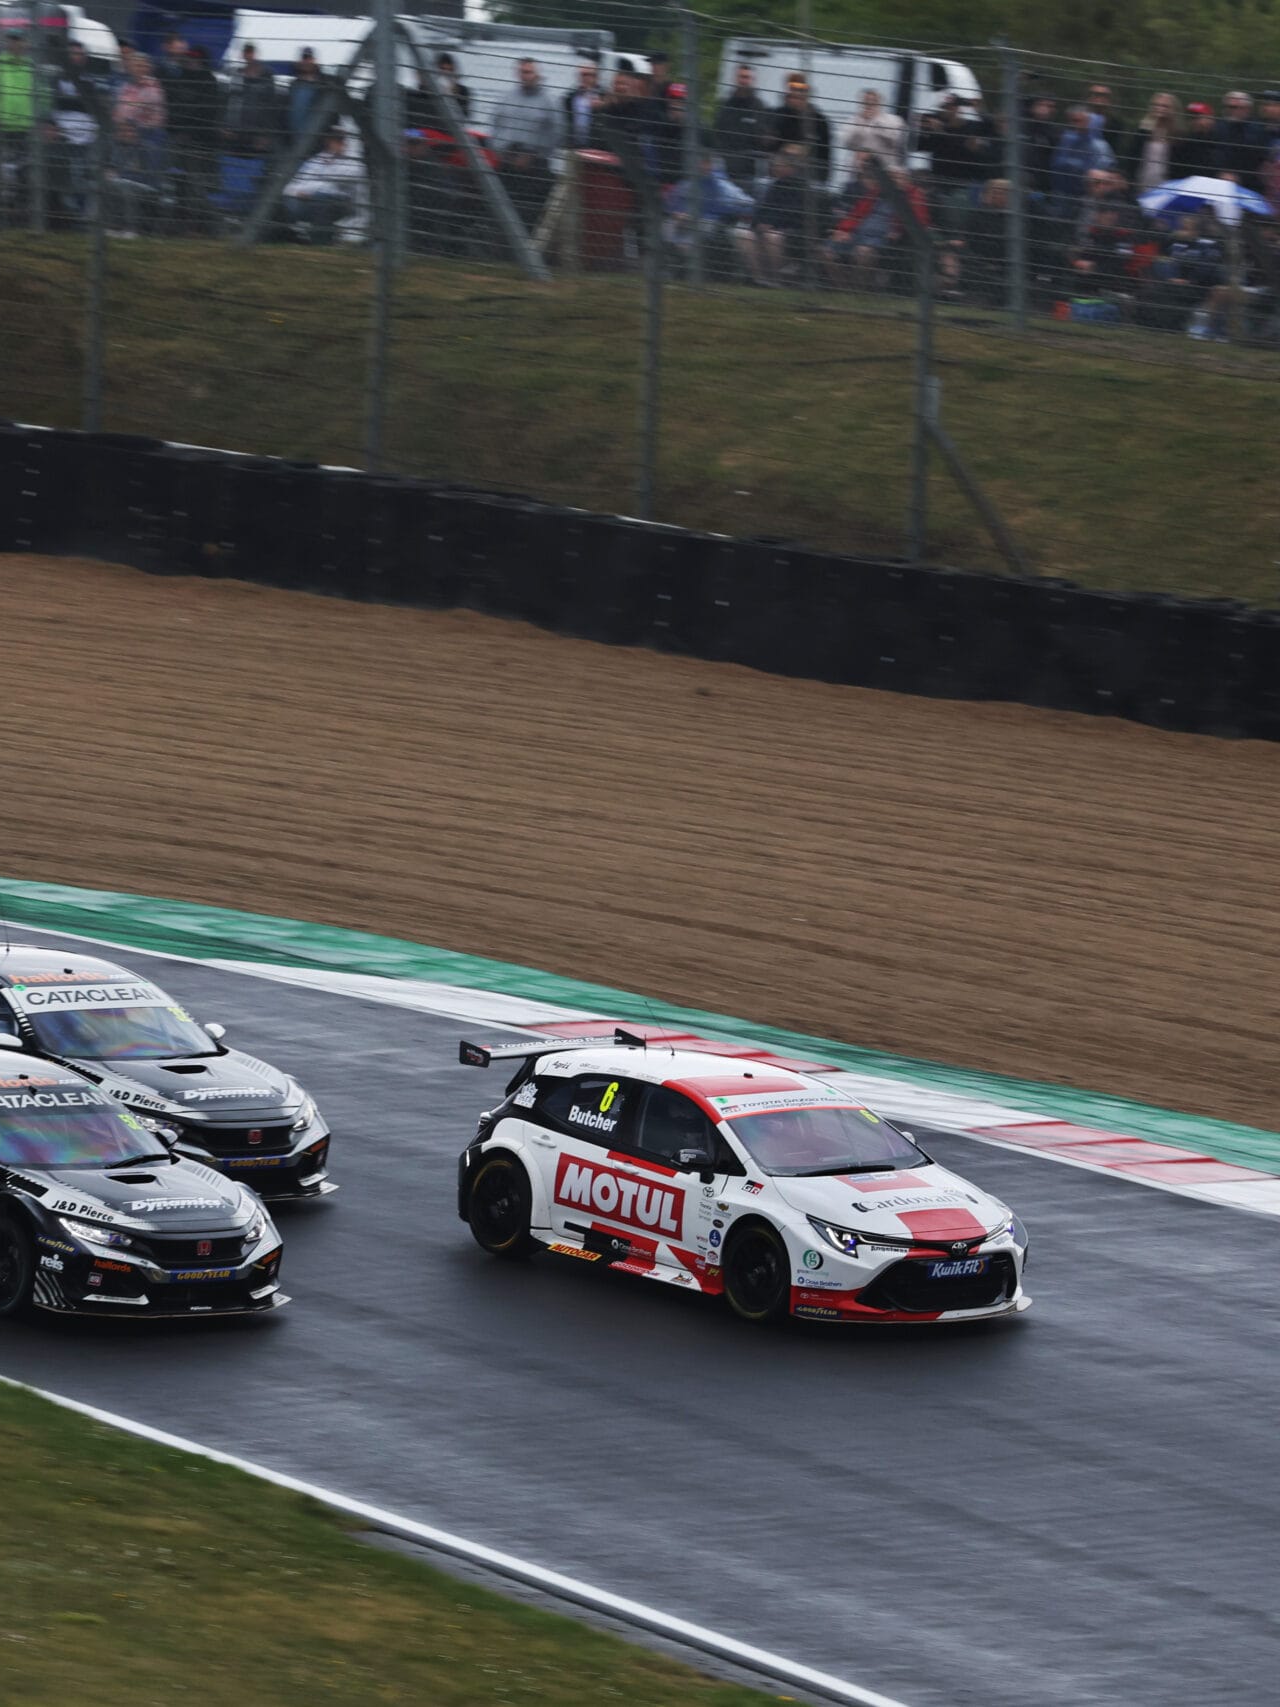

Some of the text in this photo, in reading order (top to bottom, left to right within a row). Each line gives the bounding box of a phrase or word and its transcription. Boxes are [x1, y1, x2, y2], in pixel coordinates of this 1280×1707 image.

[8, 971, 110, 985] halfords
[26, 987, 161, 1006] CATACLEAN
[131, 1094, 167, 1111] Pierce
[599, 1081, 619, 1112] 6
[568, 1105, 618, 1132] Butcher
[559, 1162, 678, 1232] MOTUL
[52, 1200, 114, 1222] J&D Pierce
[553, 1243, 598, 1261] AUTOCAR
[40, 1253, 65, 1271] reis
[94, 1258, 132, 1273] halfords
